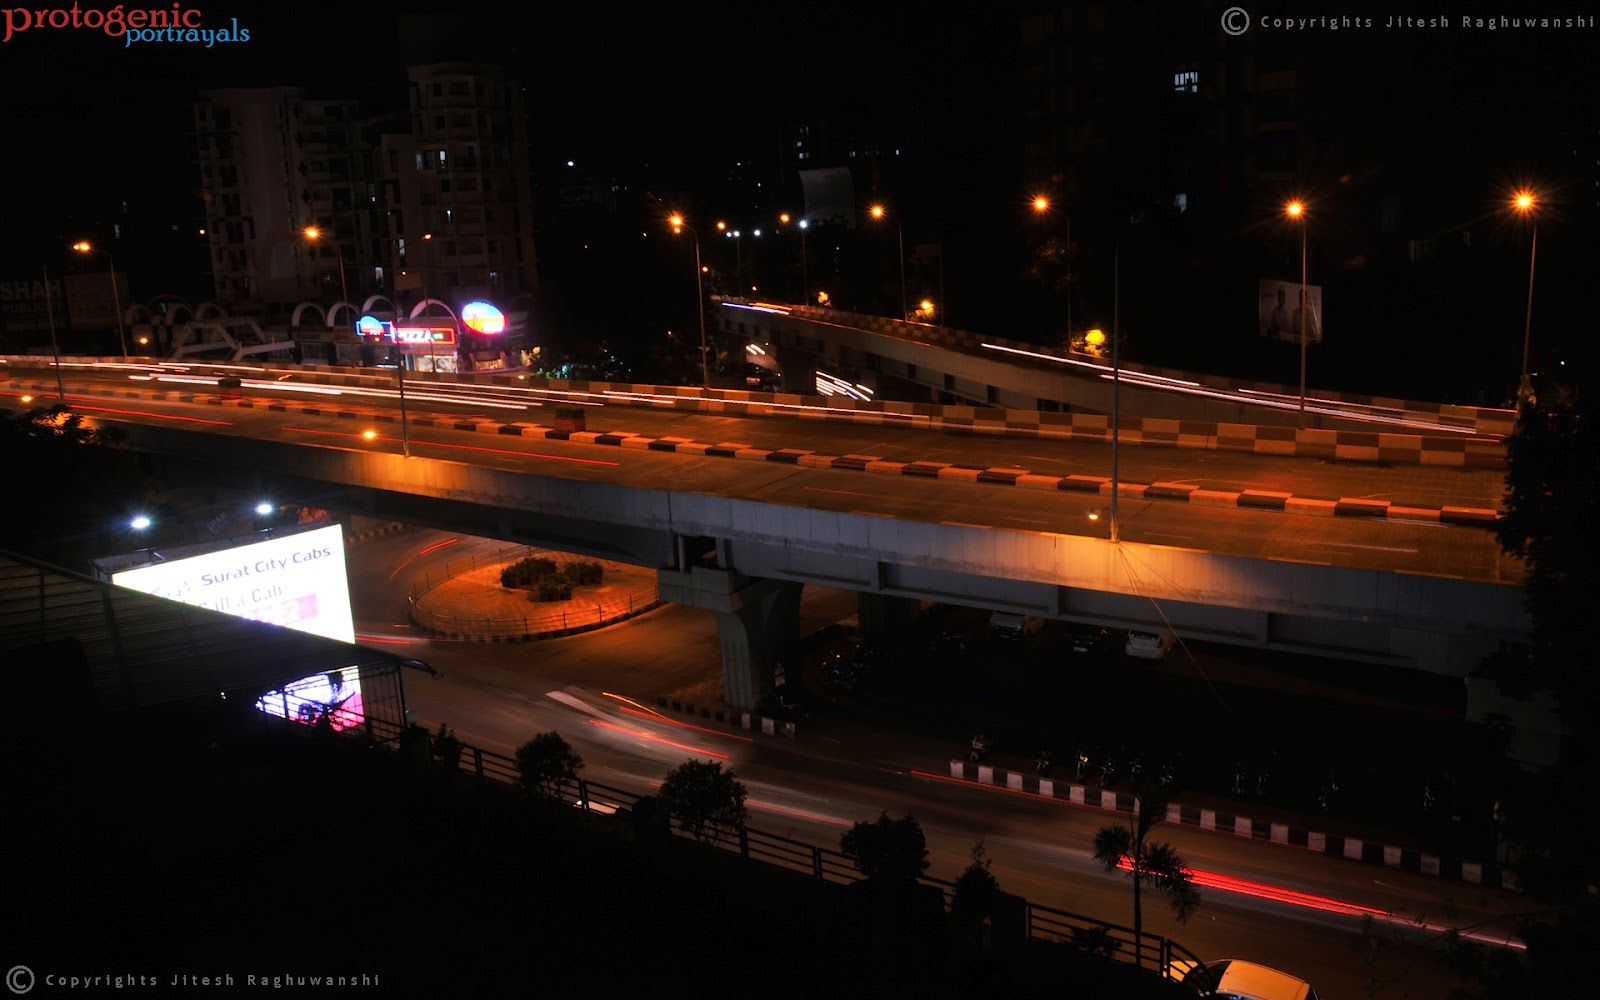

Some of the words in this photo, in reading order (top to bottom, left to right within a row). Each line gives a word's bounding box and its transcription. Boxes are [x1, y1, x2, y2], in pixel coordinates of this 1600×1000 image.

[200, 564, 251, 587] Surat
[254, 556, 288, 573] City
[292, 546, 331, 564] Cabs
[252, 584, 283, 603] Cab
